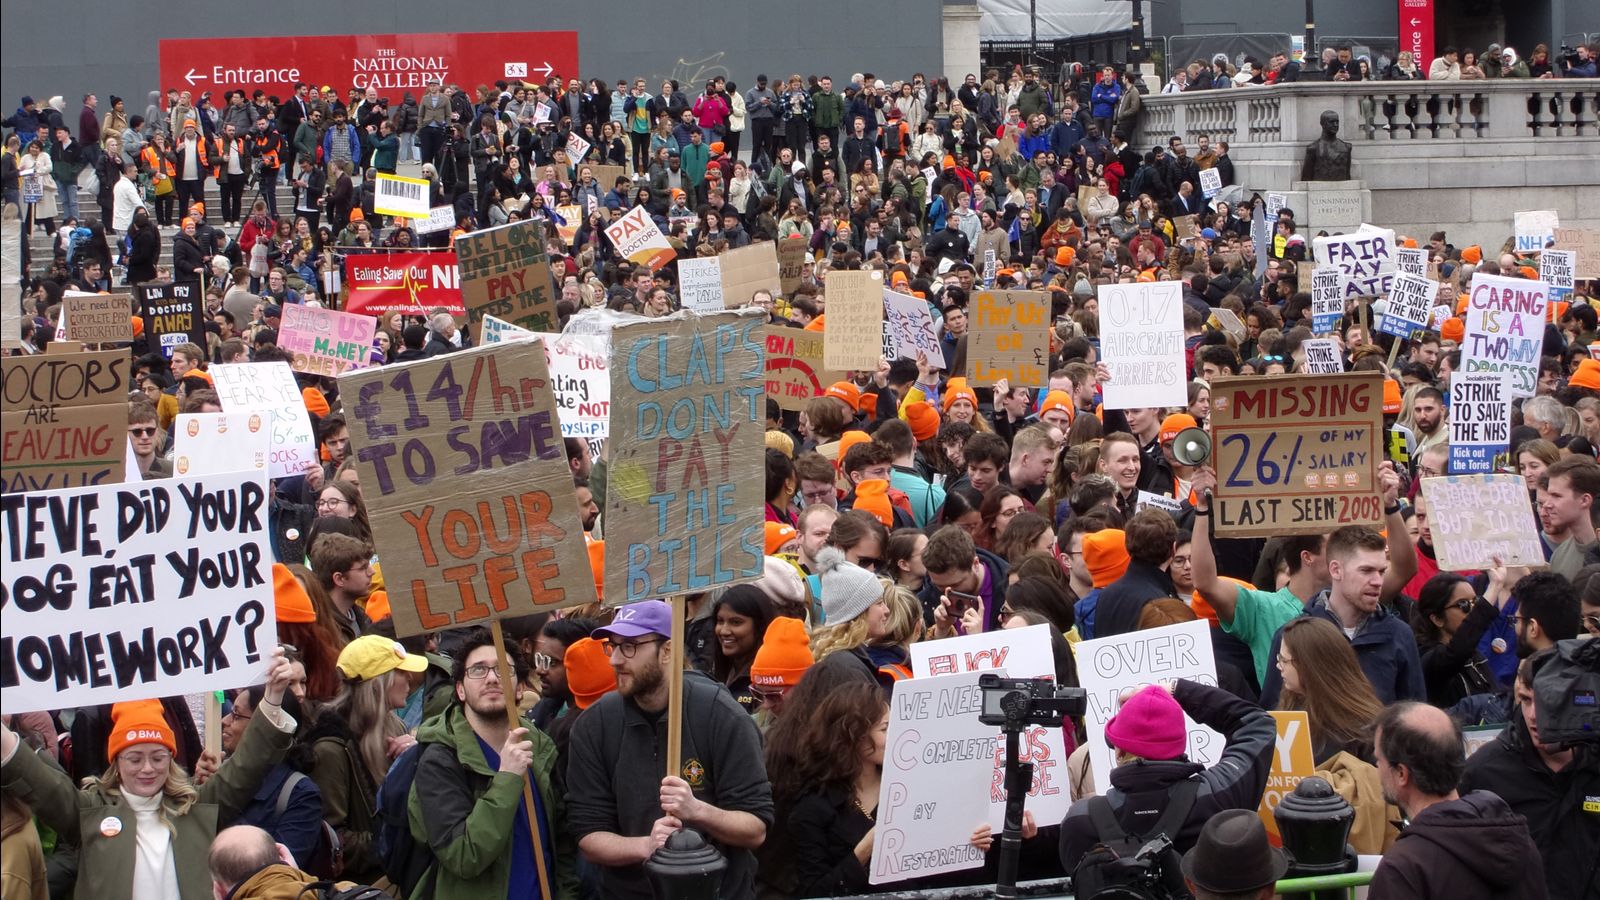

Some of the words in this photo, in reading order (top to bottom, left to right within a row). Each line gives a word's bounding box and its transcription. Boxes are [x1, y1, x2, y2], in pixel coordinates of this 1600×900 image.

[377, 49, 396, 58] THE
[353, 57, 448, 72] NATIONAL
[213, 66, 300, 84] Entrance
[353, 72, 448, 88] GALLERY
[568, 132, 589, 152] PAY
[608, 209, 646, 246] PAY
[458, 222, 541, 258] BELOW
[622, 228, 658, 256] DOCTORS
[1327, 237, 1390, 264] FAIR
[1542, 254, 1568, 267] STRIKE
[354, 267, 382, 284] Ealing
[384, 266, 403, 281] Save
[410, 266, 428, 280] Our
[682, 266, 720, 279] STRIKES
[1404, 263, 1424, 275] SAVE
[1542, 265, 1551, 276] TO
[1552, 266, 1572, 277] SAVE
[486, 269, 526, 300] PAY
[1313, 274, 1338, 288] STRIKE
[1345, 276, 1393, 297] ATE
[1395, 278, 1429, 298] STRIKE
[1556, 276, 1572, 287] NHS
[147, 288, 164, 300] LOW
[174, 286, 190, 298] PAY
[516, 286, 548, 309] THE
[711, 290, 722, 300] US
[1313, 289, 1321, 300] TO
[1324, 287, 1342, 300] SAVE
[1392, 290, 1404, 303] TO
[1406, 294, 1430, 312] SAVE
[1472, 284, 1544, 316] CARING
[70, 301, 85, 312] We
[90, 300, 109, 310] need
[112, 298, 129, 310] CPR
[149, 302, 193, 316] DOCTORS
[1313, 302, 1326, 314] THE
[1328, 300, 1342, 312] NHS
[1388, 302, 1406, 317] THE
[1408, 307, 1428, 323] NHS
[71, 313, 110, 326] COMPLETE
[112, 312, 128, 325] PAY
[153, 314, 192, 334] AWAY
[338, 316, 370, 342] US
[898, 310, 915, 345] PAY
[1384, 316, 1397, 326] Kick
[1398, 321, 1407, 329] out
[1482, 310, 1500, 333] IS
[1508, 314, 1524, 336] A
[71, 326, 133, 340] RESTORATION
[162, 336, 174, 344] SAVE
[176, 335, 187, 344] OUR
[280, 330, 312, 350] THE
[918, 308, 940, 355] STAY
[1392, 327, 1409, 338] Tories
[786, 337, 794, 356] A
[996, 334, 1022, 352] OR
[1105, 330, 1184, 357] AIRCRAFT
[1470, 334, 1508, 362] TWO
[292, 354, 345, 376] ONEY
[578, 354, 606, 371] the
[627, 319, 765, 394] CLAPS
[1307, 348, 1335, 363] STRIKE
[213, 366, 260, 385] HEAR
[272, 364, 292, 382] YE
[1104, 362, 1176, 386] CARRIERS
[1310, 364, 1320, 373] TO
[1322, 363, 1340, 373] SAVE
[0, 358, 124, 404] OCTORS
[785, 382, 808, 398] THIS
[220, 385, 269, 406] HEAR
[274, 384, 301, 403] YE
[353, 354, 546, 440] £14/hr
[1232, 383, 1370, 420] MISSING
[1454, 383, 1502, 402] STRIKE
[24, 404, 61, 424] ARE
[578, 402, 610, 418] NOT
[636, 385, 764, 441] DON'T
[1454, 403, 1472, 422] TO
[1476, 402, 1506, 422] SAVE
[294, 434, 310, 444] OFF
[1320, 430, 1338, 443] OF
[1344, 429, 1366, 441] MY
[1453, 423, 1479, 442] THE
[1484, 422, 1508, 442] NHS
[2, 424, 114, 462] EAVING
[1454, 448, 1470, 458] Kick
[1472, 448, 1486, 458] out
[358, 438, 436, 496] TO
[446, 411, 560, 476] SAVE
[656, 422, 740, 493] PAY
[1222, 432, 1304, 488] 26%
[1308, 452, 1368, 470] SALARY
[1454, 460, 1466, 470] the
[1468, 460, 1490, 470] Tories
[649, 483, 737, 536] THE
[1150, 496, 1168, 506] Socialist
[1220, 499, 1282, 526] LAST
[1292, 496, 1337, 522] SEEN:
[1338, 496, 1381, 523] 2008
[0, 492, 116, 562] TEVE,
[177, 481, 264, 539] YOUR
[400, 490, 567, 568] YOUR
[1436, 511, 1474, 534] BUT
[1444, 540, 1487, 565] MORE
[626, 524, 764, 602] BILLS
[0, 563, 78, 613] OG
[89, 554, 156, 610] EAT
[166, 542, 266, 600] YOUR
[411, 548, 566, 630] LIFE
[1094, 633, 1200, 678] OVER
[762, 675, 784, 684] BMA
[899, 692, 932, 720] WE
[936, 685, 982, 719] NEE
[138, 730, 162, 740] BMA
[1018, 726, 1051, 764] US
